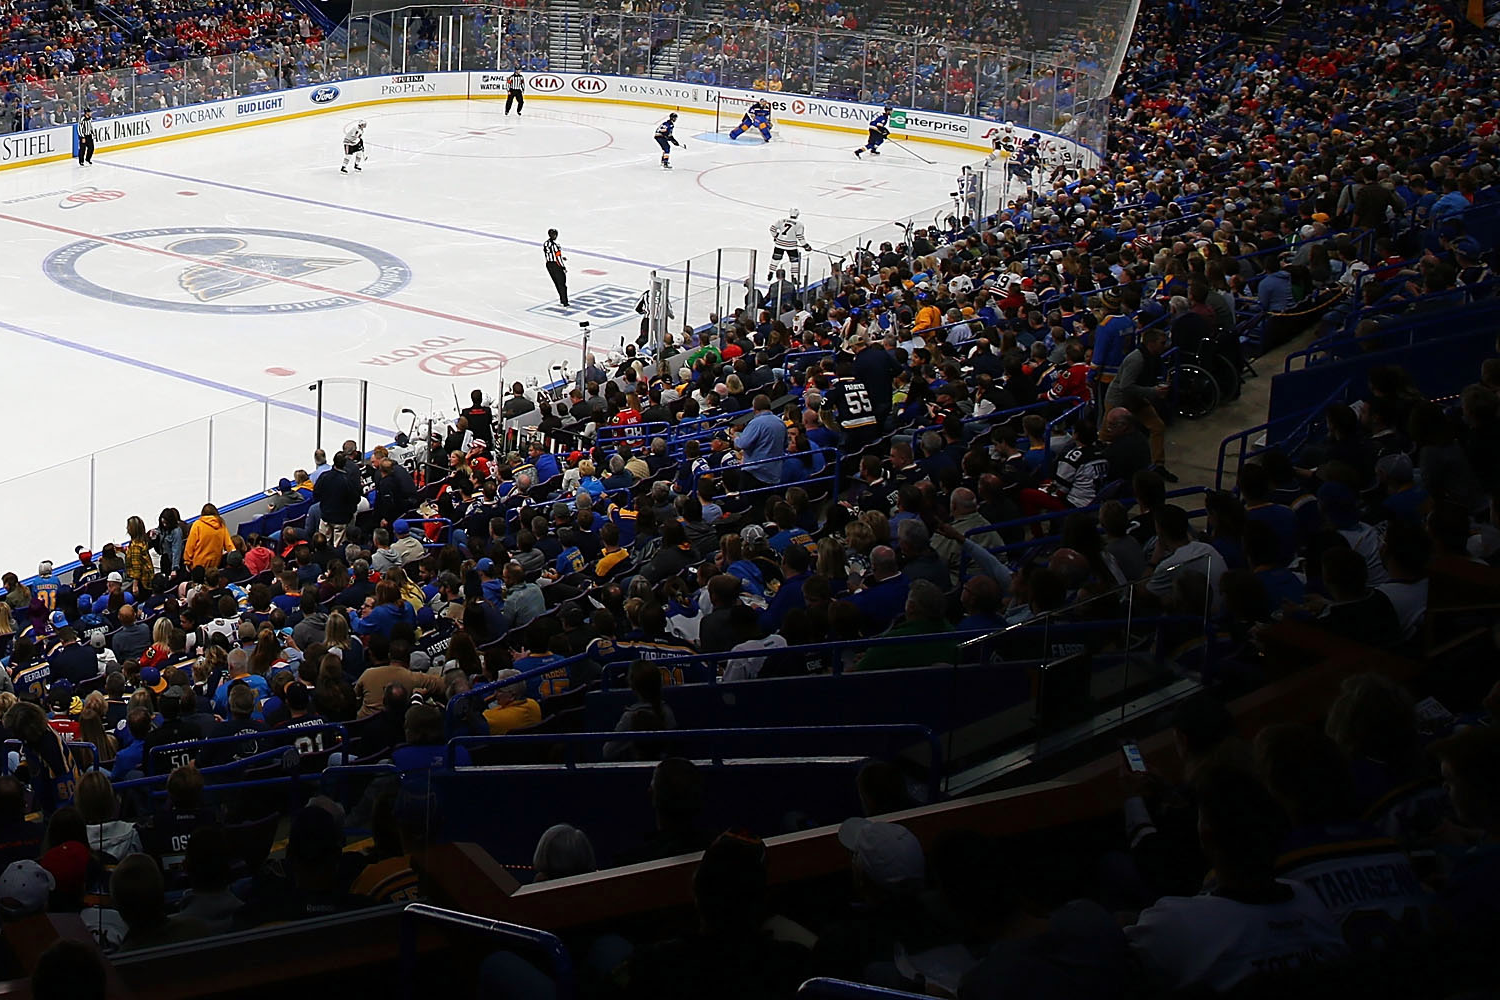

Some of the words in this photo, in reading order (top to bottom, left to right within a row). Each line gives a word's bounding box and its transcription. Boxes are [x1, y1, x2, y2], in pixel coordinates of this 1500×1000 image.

[397, 74, 425, 83] PURINA
[535, 77, 558, 90] KIA
[577, 79, 601, 92] KIA
[313, 90, 339, 102] Ford
[618, 83, 690, 101] MONSANTO
[237, 101, 257, 115] BUD
[257, 96, 283, 112] LIGHT
[91, 126, 112, 143] ACK
[113, 116, 153, 141] DANIEL'S
[3, 134, 56, 162] STIFEL
[781, 223, 792, 236] 7
[360, 335, 465, 368] TOYOTA
[845, 391, 873, 414] 55
